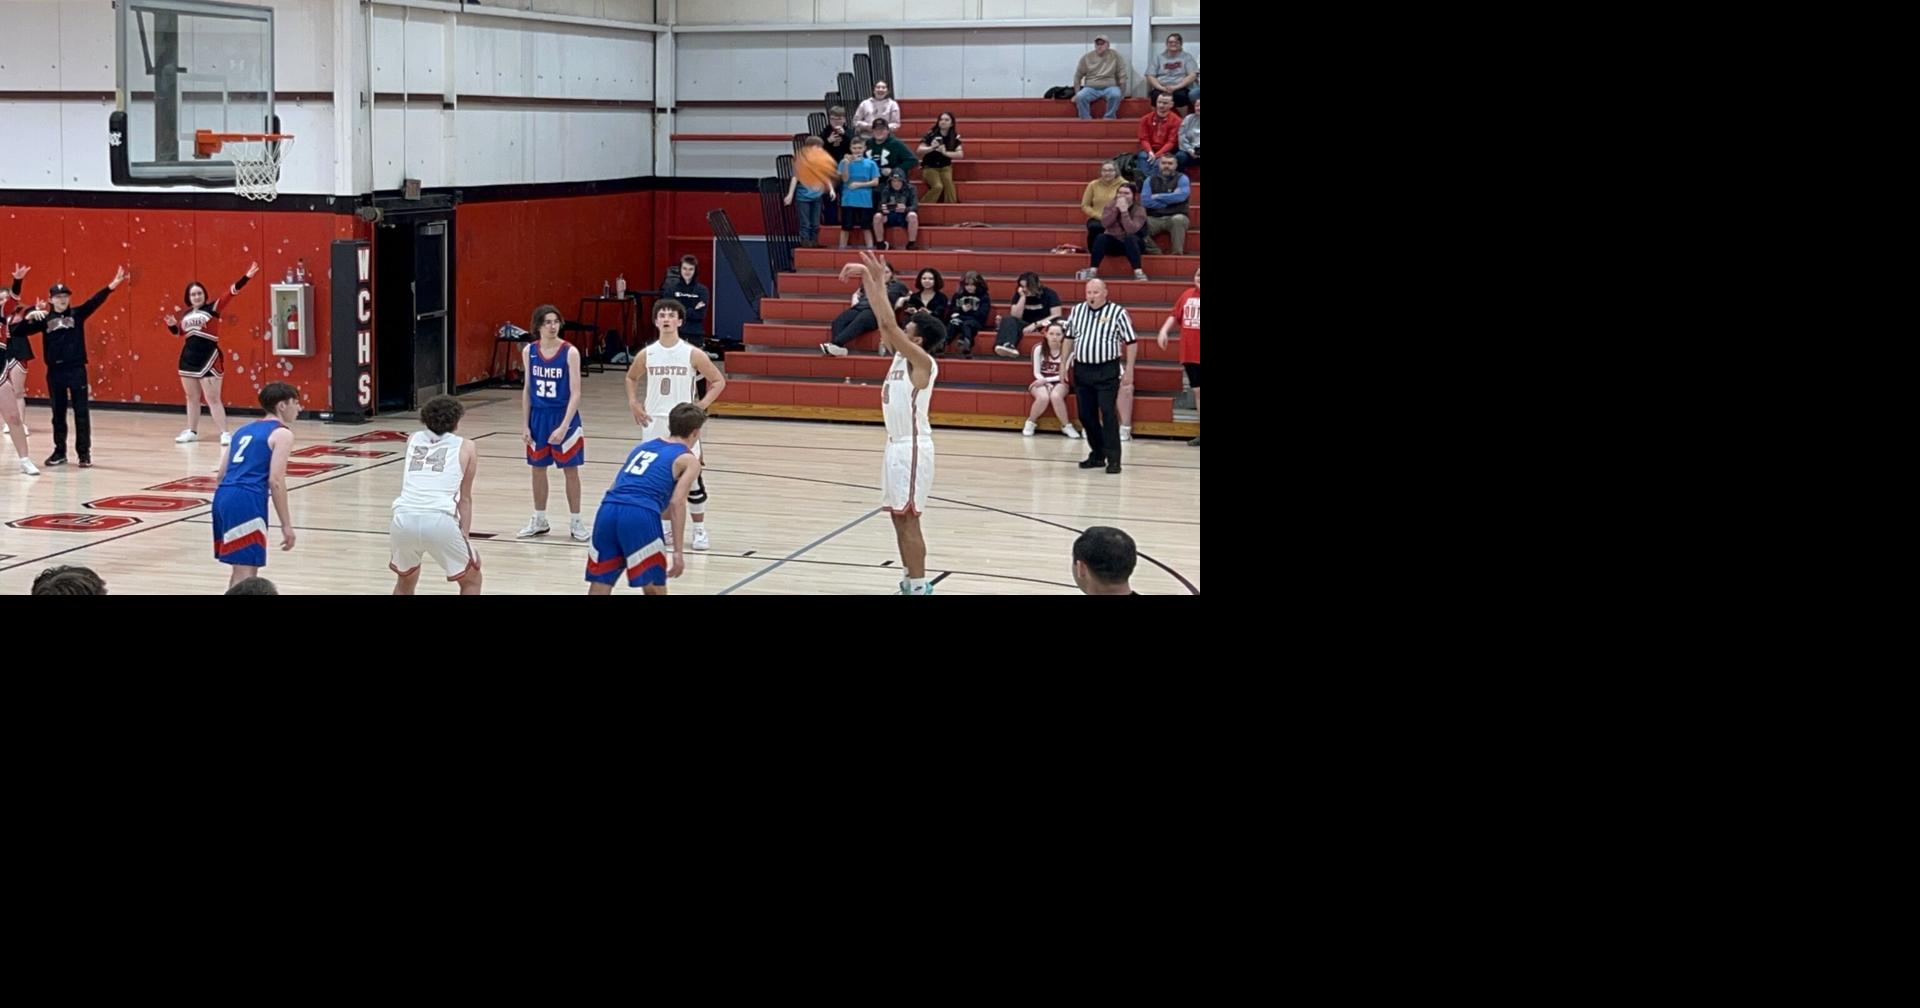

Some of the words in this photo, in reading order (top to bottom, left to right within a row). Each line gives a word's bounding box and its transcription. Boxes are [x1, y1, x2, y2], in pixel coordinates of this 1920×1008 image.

[357, 248, 371, 406] WCHS
[532, 365, 563, 379] GILMER
[648, 365, 688, 376] WEBSTER
[536, 380, 557, 398] 33
[660, 377, 671, 396] 0
[232, 435, 253, 463] 2
[408, 445, 448, 472] 24
[624, 450, 659, 475] 13
